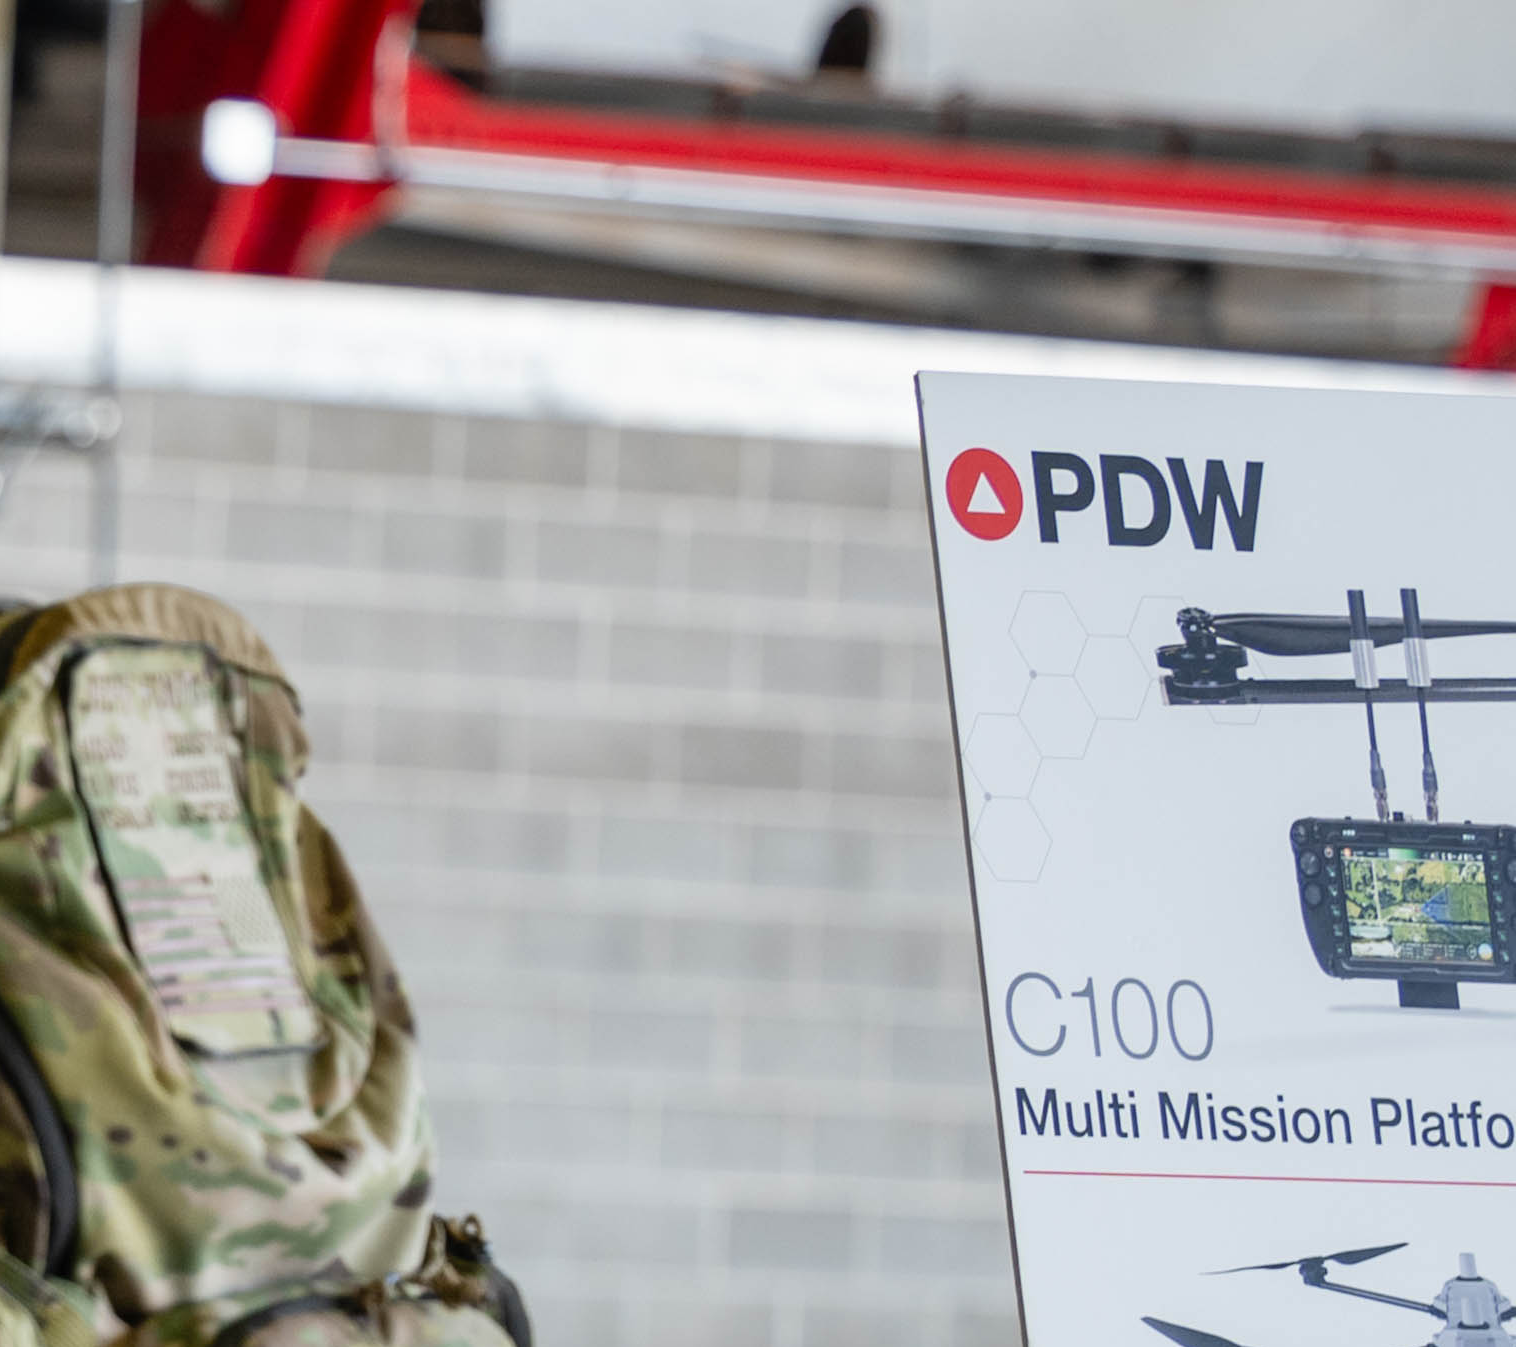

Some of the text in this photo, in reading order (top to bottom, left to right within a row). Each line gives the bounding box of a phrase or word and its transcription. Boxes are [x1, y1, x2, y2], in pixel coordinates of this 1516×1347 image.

[1030, 450, 1264, 553] PDW
[1004, 972, 1214, 1062] C100
[1014, 1087, 1140, 1139] Multi
[1159, 1092, 1352, 1146] Mission
